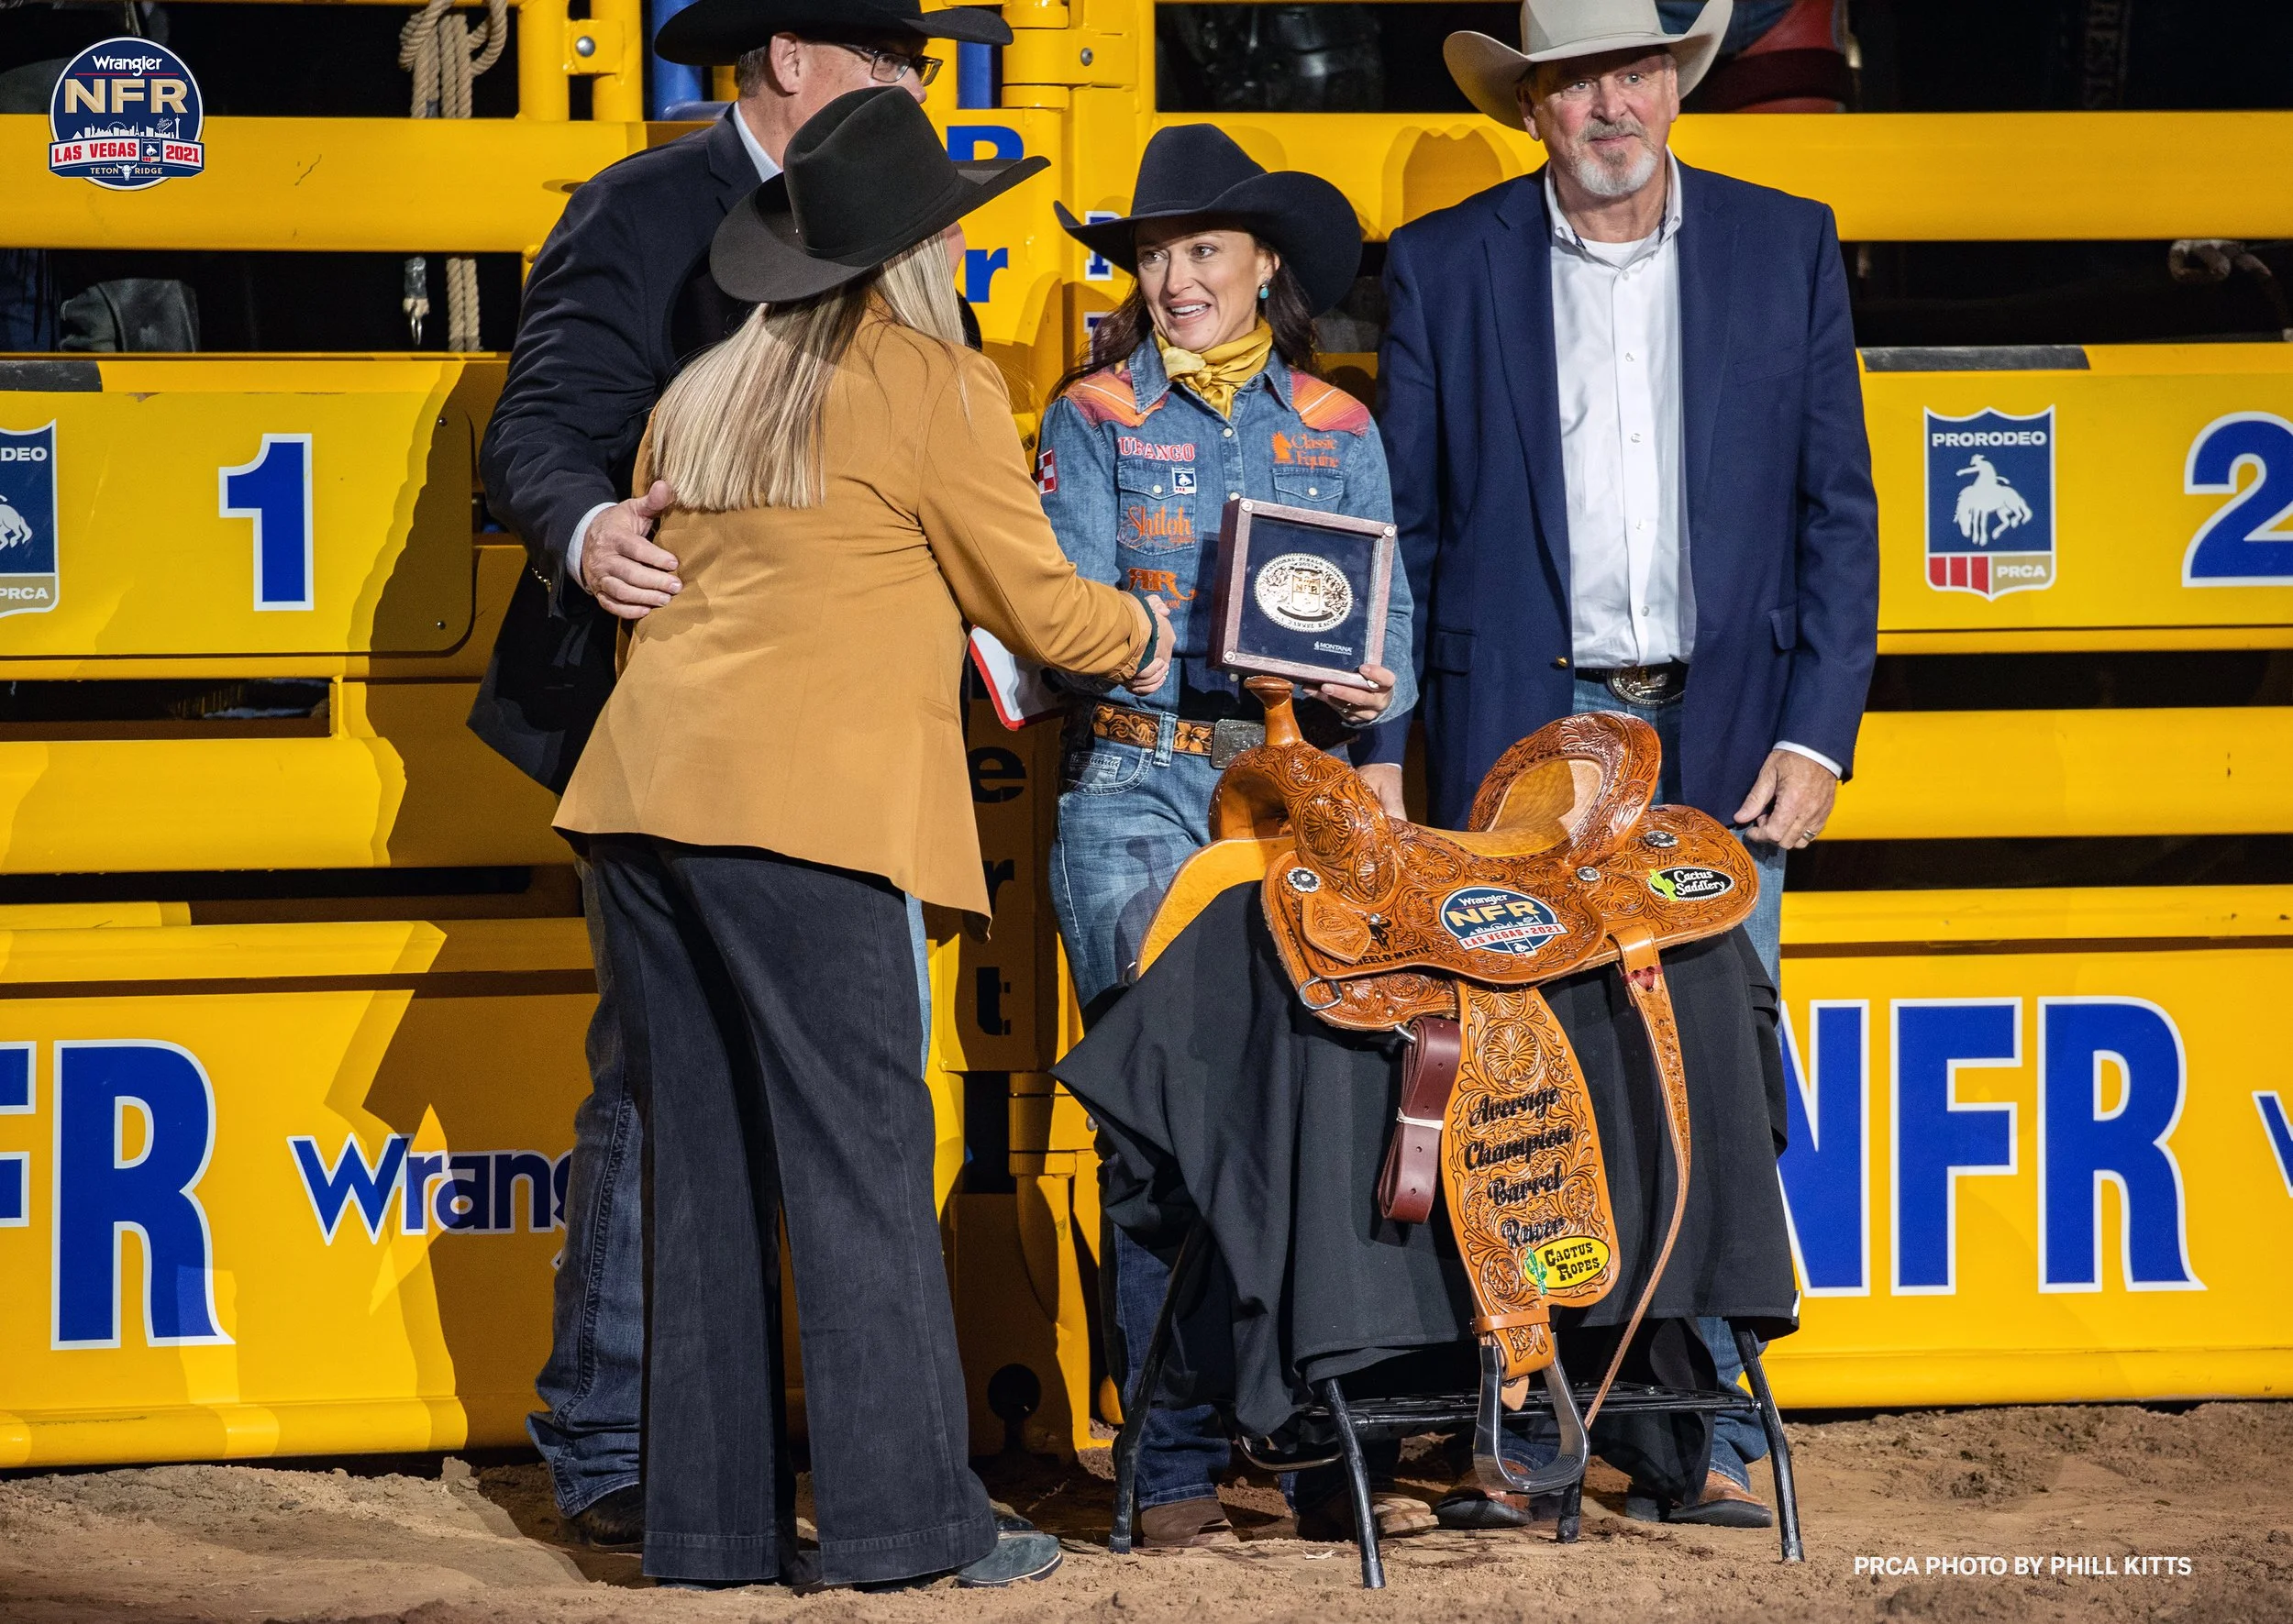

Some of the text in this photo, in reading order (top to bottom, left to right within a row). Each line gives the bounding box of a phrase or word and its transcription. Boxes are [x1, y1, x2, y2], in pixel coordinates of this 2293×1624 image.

[1932, 431, 2047, 447] PRORODEO
[2183, 412, 2293, 587] 2
[218, 434, 314, 611] 1
[1997, 565, 2045, 578] PRCA
[1674, 870, 1714, 883] Cactus
[1675, 880, 1725, 896] Saddlery
[1446, 900, 1540, 927] NFR
[1458, 894, 1508, 905] Wrangler
[1463, 936, 1482, 947] LAS
[1489, 929, 1523, 942] VEGAS
[1530, 925, 1562, 934] 2021
[1468, 1086, 1560, 1128] Average
[1464, 1123, 1574, 1171] Champion
[1777, 995, 2208, 1298] NFR
[1487, 1163, 1565, 1207] Barrel
[1501, 1216, 1567, 1250] Racer
